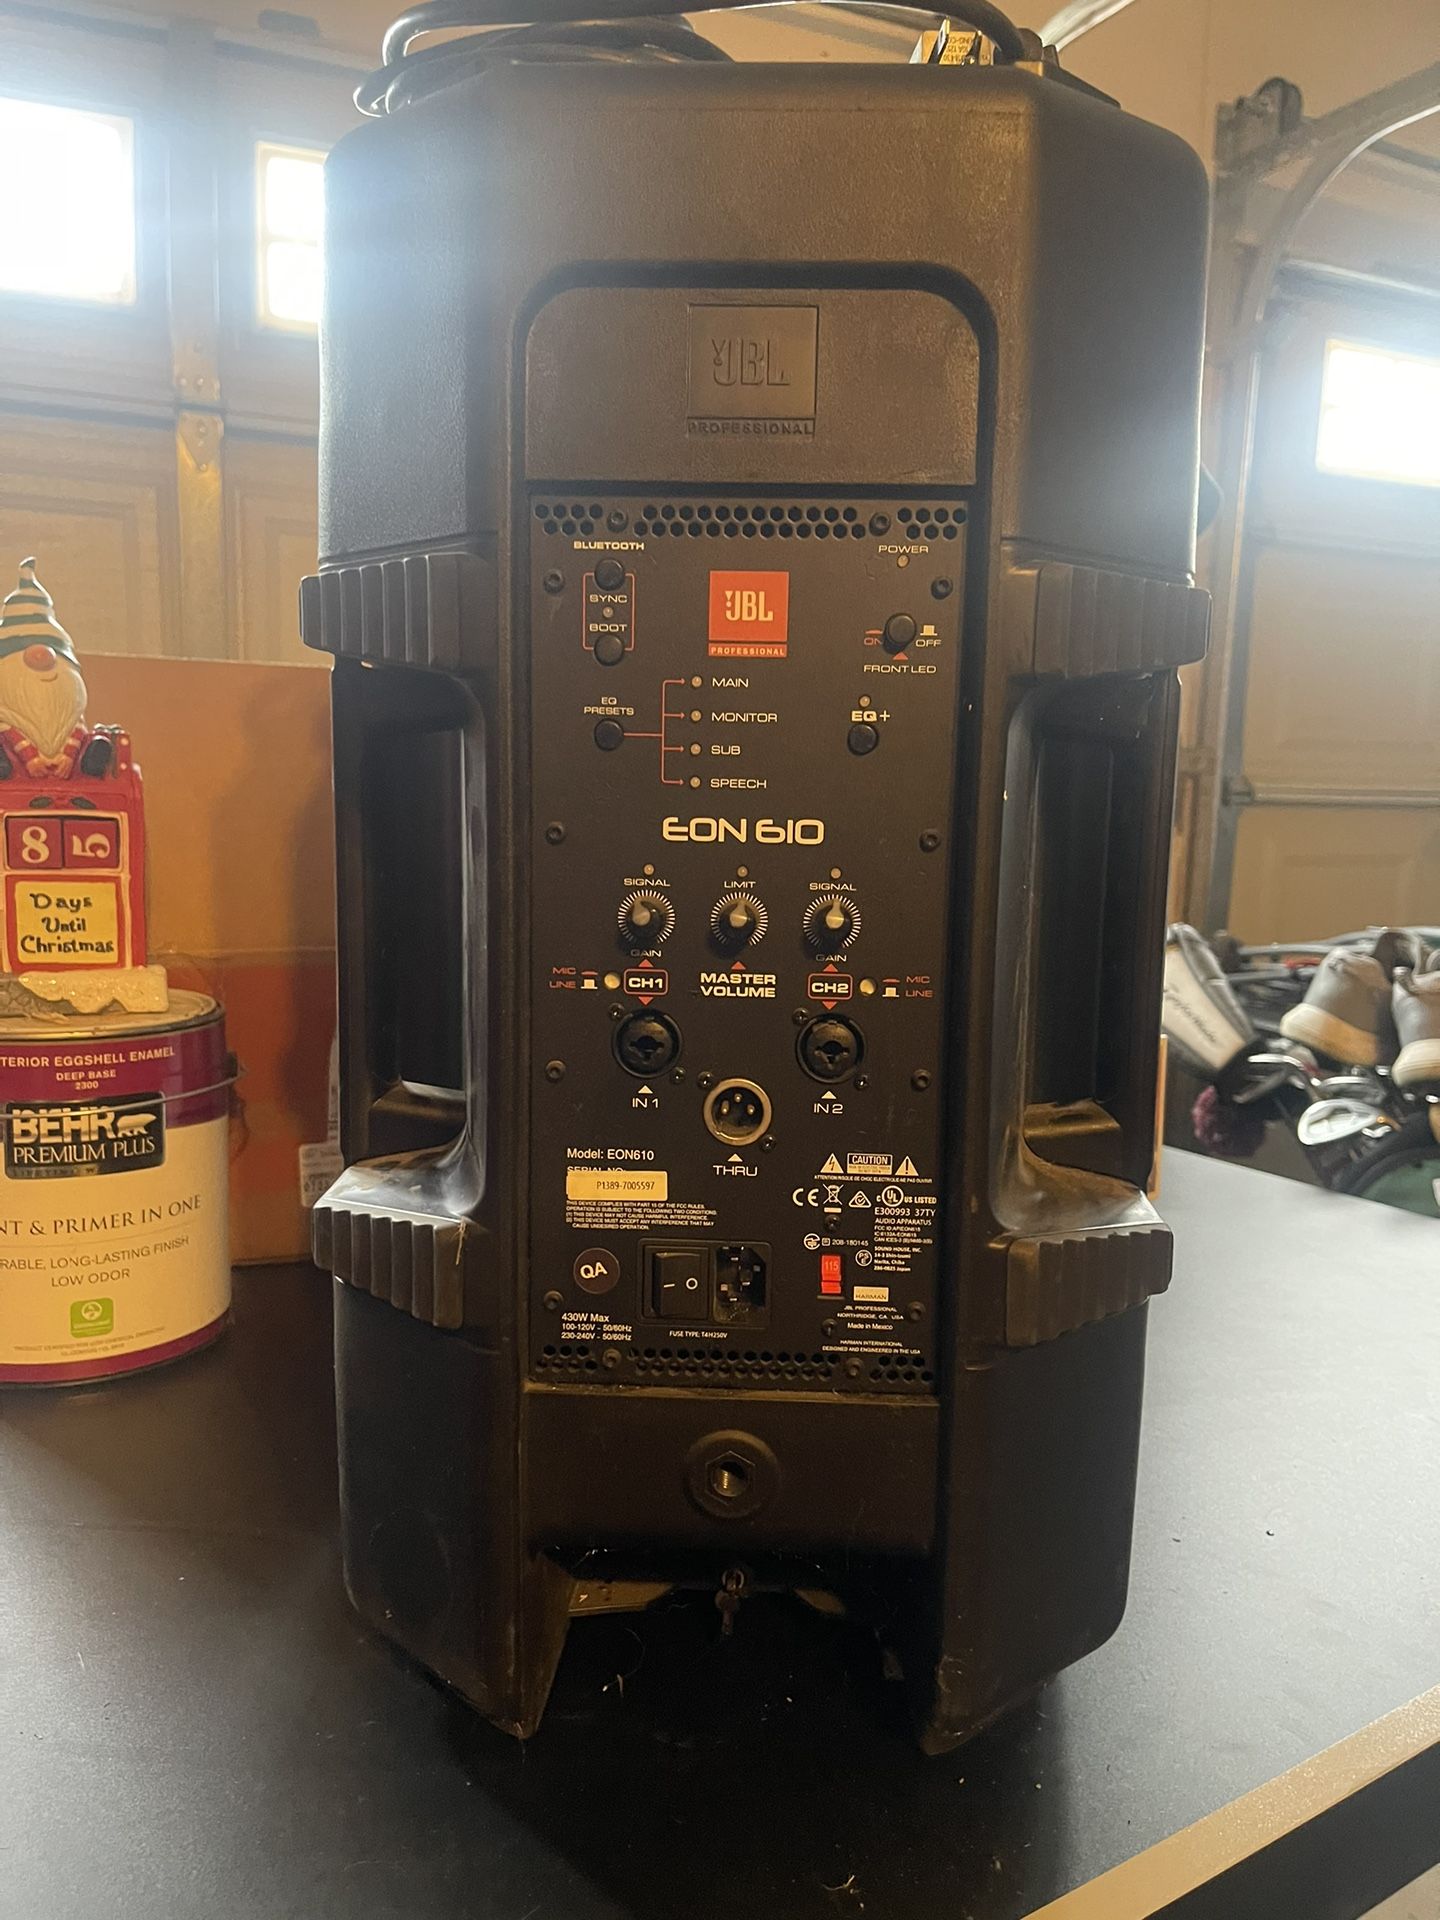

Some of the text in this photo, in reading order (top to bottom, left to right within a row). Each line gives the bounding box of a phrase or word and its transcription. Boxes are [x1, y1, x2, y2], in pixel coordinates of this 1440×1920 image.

[710, 338, 792, 387] JBL
[687, 421, 814, 435] PROFESSIONAL
[573, 541, 645, 550] BLUETOOTH
[878, 544, 929, 554] POWER
[589, 594, 628, 603] SYNC
[725, 590, 774, 622] JBL
[589, 623, 628, 632] BOOT
[915, 639, 941, 647] OFF
[710, 646, 785, 656] PROFESSIONAL
[863, 664, 937, 674] FRONT LED
[712, 677, 749, 688] MAIN
[601, 697, 617, 706] EQ
[583, 706, 634, 716] PRESETS
[711, 712, 778, 723] MONITOR
[710, 745, 741, 755] SUB
[710, 778, 767, 789] SPEECH
[662, 816, 825, 845] EON 610
[21, 825, 50, 864] 8
[72, 833, 110, 859] 5
[623, 878, 670, 887] SIGNAL
[723, 880, 756, 889] LIMIT
[809, 882, 856, 891] SIGNAL
[29, 892, 93, 914] Days
[41, 917, 86, 933] Until
[20, 935, 114, 954] Christmas
[552, 967, 576, 975] MIC
[628, 978, 663, 988] CH1
[700, 972, 777, 985] MASTER
[906, 976, 930, 984] MIC
[549, 980, 576, 988] LINE
[811, 982, 849, 993] CH2
[700, 986, 776, 998] VOLUME
[0, 1046, 176, 1068] TERIOR EGGSHELL ENAMEL
[56, 1069, 116, 1081] DEEP BASE
[75, 1081, 99, 1090] 2300
[12, 1106, 116, 1144] BEHR
[13, 1136, 156, 1164] PREMIUM PLUS
[567, 1148, 654, 1160] Model: EON610
[852, 1155, 888, 1165] CAUTION
[713, 1165, 758, 1176] THRU
[596, 1181, 655, 1190] P1389-7005597
[914, 1196, 937, 1204] LISTED
[29, 1220, 47, 1235] &
[53, 1211, 135, 1235] PRIMER
[141, 1205, 162, 1223] IN
[168, 1194, 201, 1217] ONE
[875, 1207, 935, 1217] E300993 37TY
[896, 1218, 932, 1226] APPARATUS
[50, 1246, 151, 1269] LONG-LASTING
[153, 1235, 190, 1254] FINISH
[580, 1261, 608, 1279] QA
[51, 1268, 130, 1287] LOW ODOR
[561, 1312, 610, 1322] 430W Max
[562, 1323, 595, 1331] 100-120V
